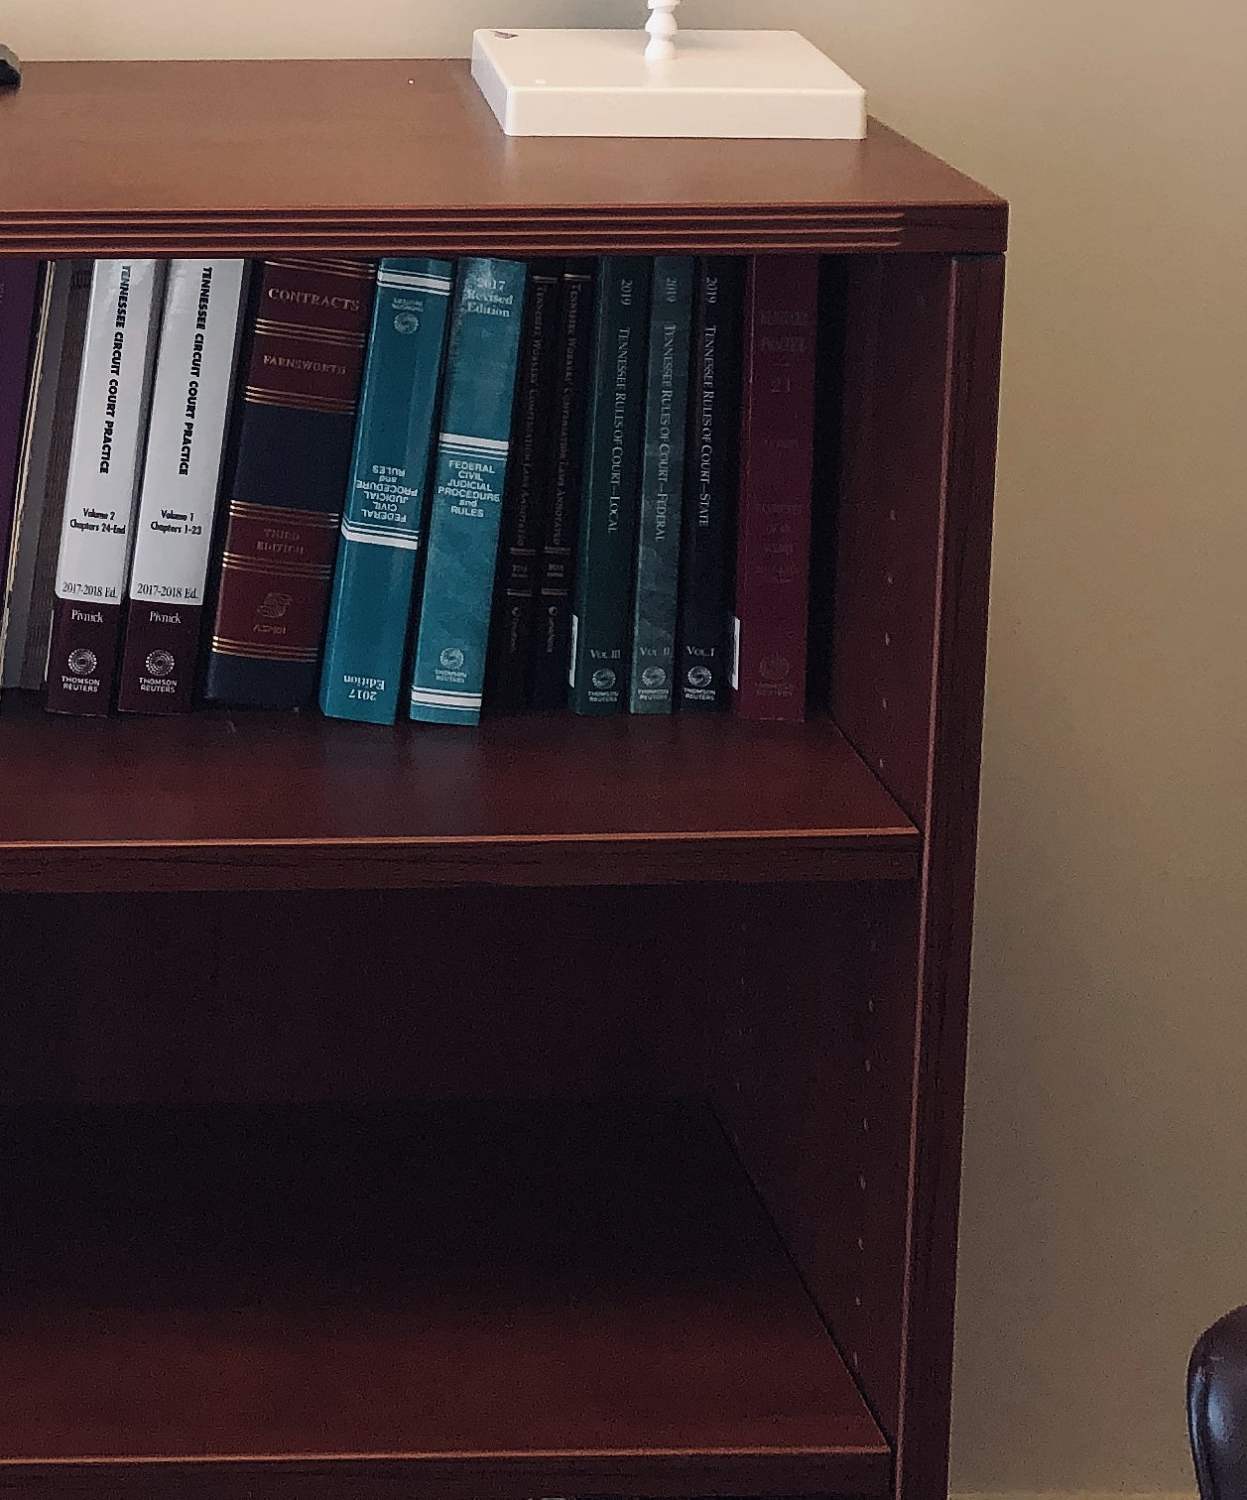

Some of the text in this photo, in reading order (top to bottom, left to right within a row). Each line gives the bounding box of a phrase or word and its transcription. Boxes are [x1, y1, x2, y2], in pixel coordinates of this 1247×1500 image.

[476, 277, 506, 293] 2017
[620, 278, 633, 306] 2019
[705, 276, 719, 305] 2019
[268, 287, 360, 312] CONTRACTS
[466, 288, 514, 305] Revised
[467, 301, 510, 317] Edition
[263, 354, 347, 375] FARNSWORTH
[616, 326, 631, 392] TENNESSEE
[661, 323, 677, 390] TENNESSEE
[703, 324, 717, 389] TENNESSEE
[99, 265, 132, 474] TENNESSEE CIRCUIT COURT PRACTICE
[178, 266, 213, 476] TENNESSEE CIRCUIT COURT PRACTICE
[614, 392, 627, 429] RULES
[659, 390, 674, 426] RULES
[701, 390, 716, 427] RULES
[612, 429, 624, 445] OF
[658, 426, 671, 443] OF
[701, 427, 712, 444] OF
[372, 465, 406, 477] RULES
[448, 459, 496, 474] FEDERAL
[378, 475, 397, 483] and
[457, 470, 483, 482] CIVIL
[355, 479, 419, 497] PROCEDURE
[446, 479, 493, 492] JUDICIAL
[363, 490, 409, 504] JUDICIAL
[437, 486, 501, 502] PROCEDURE
[372, 501, 398, 511] CIVIL
[450, 505, 484, 518] RULES
[458, 499, 478, 508] and
[83, 507, 116, 521] Volume 2
[161, 509, 194, 522] Volume 1
[361, 508, 407, 523] FEDERAL
[70, 518, 127, 535] Chapters 24-End
[150, 521, 202, 536] Chapters 1-23
[263, 527, 301, 541] THIRD
[62, 581, 103, 597] 2017-2018
[137, 582, 182, 598] 2017-2018
[611, 649, 621, 659] III
[60, 675, 101, 687] THOMSON
[62, 682, 99, 693] REUTERS
[138, 676, 178, 687] THOMSON
[140, 684, 177, 694] REUTERS
[343, 674, 385, 692] Edition
[348, 688, 378, 702] 2017
